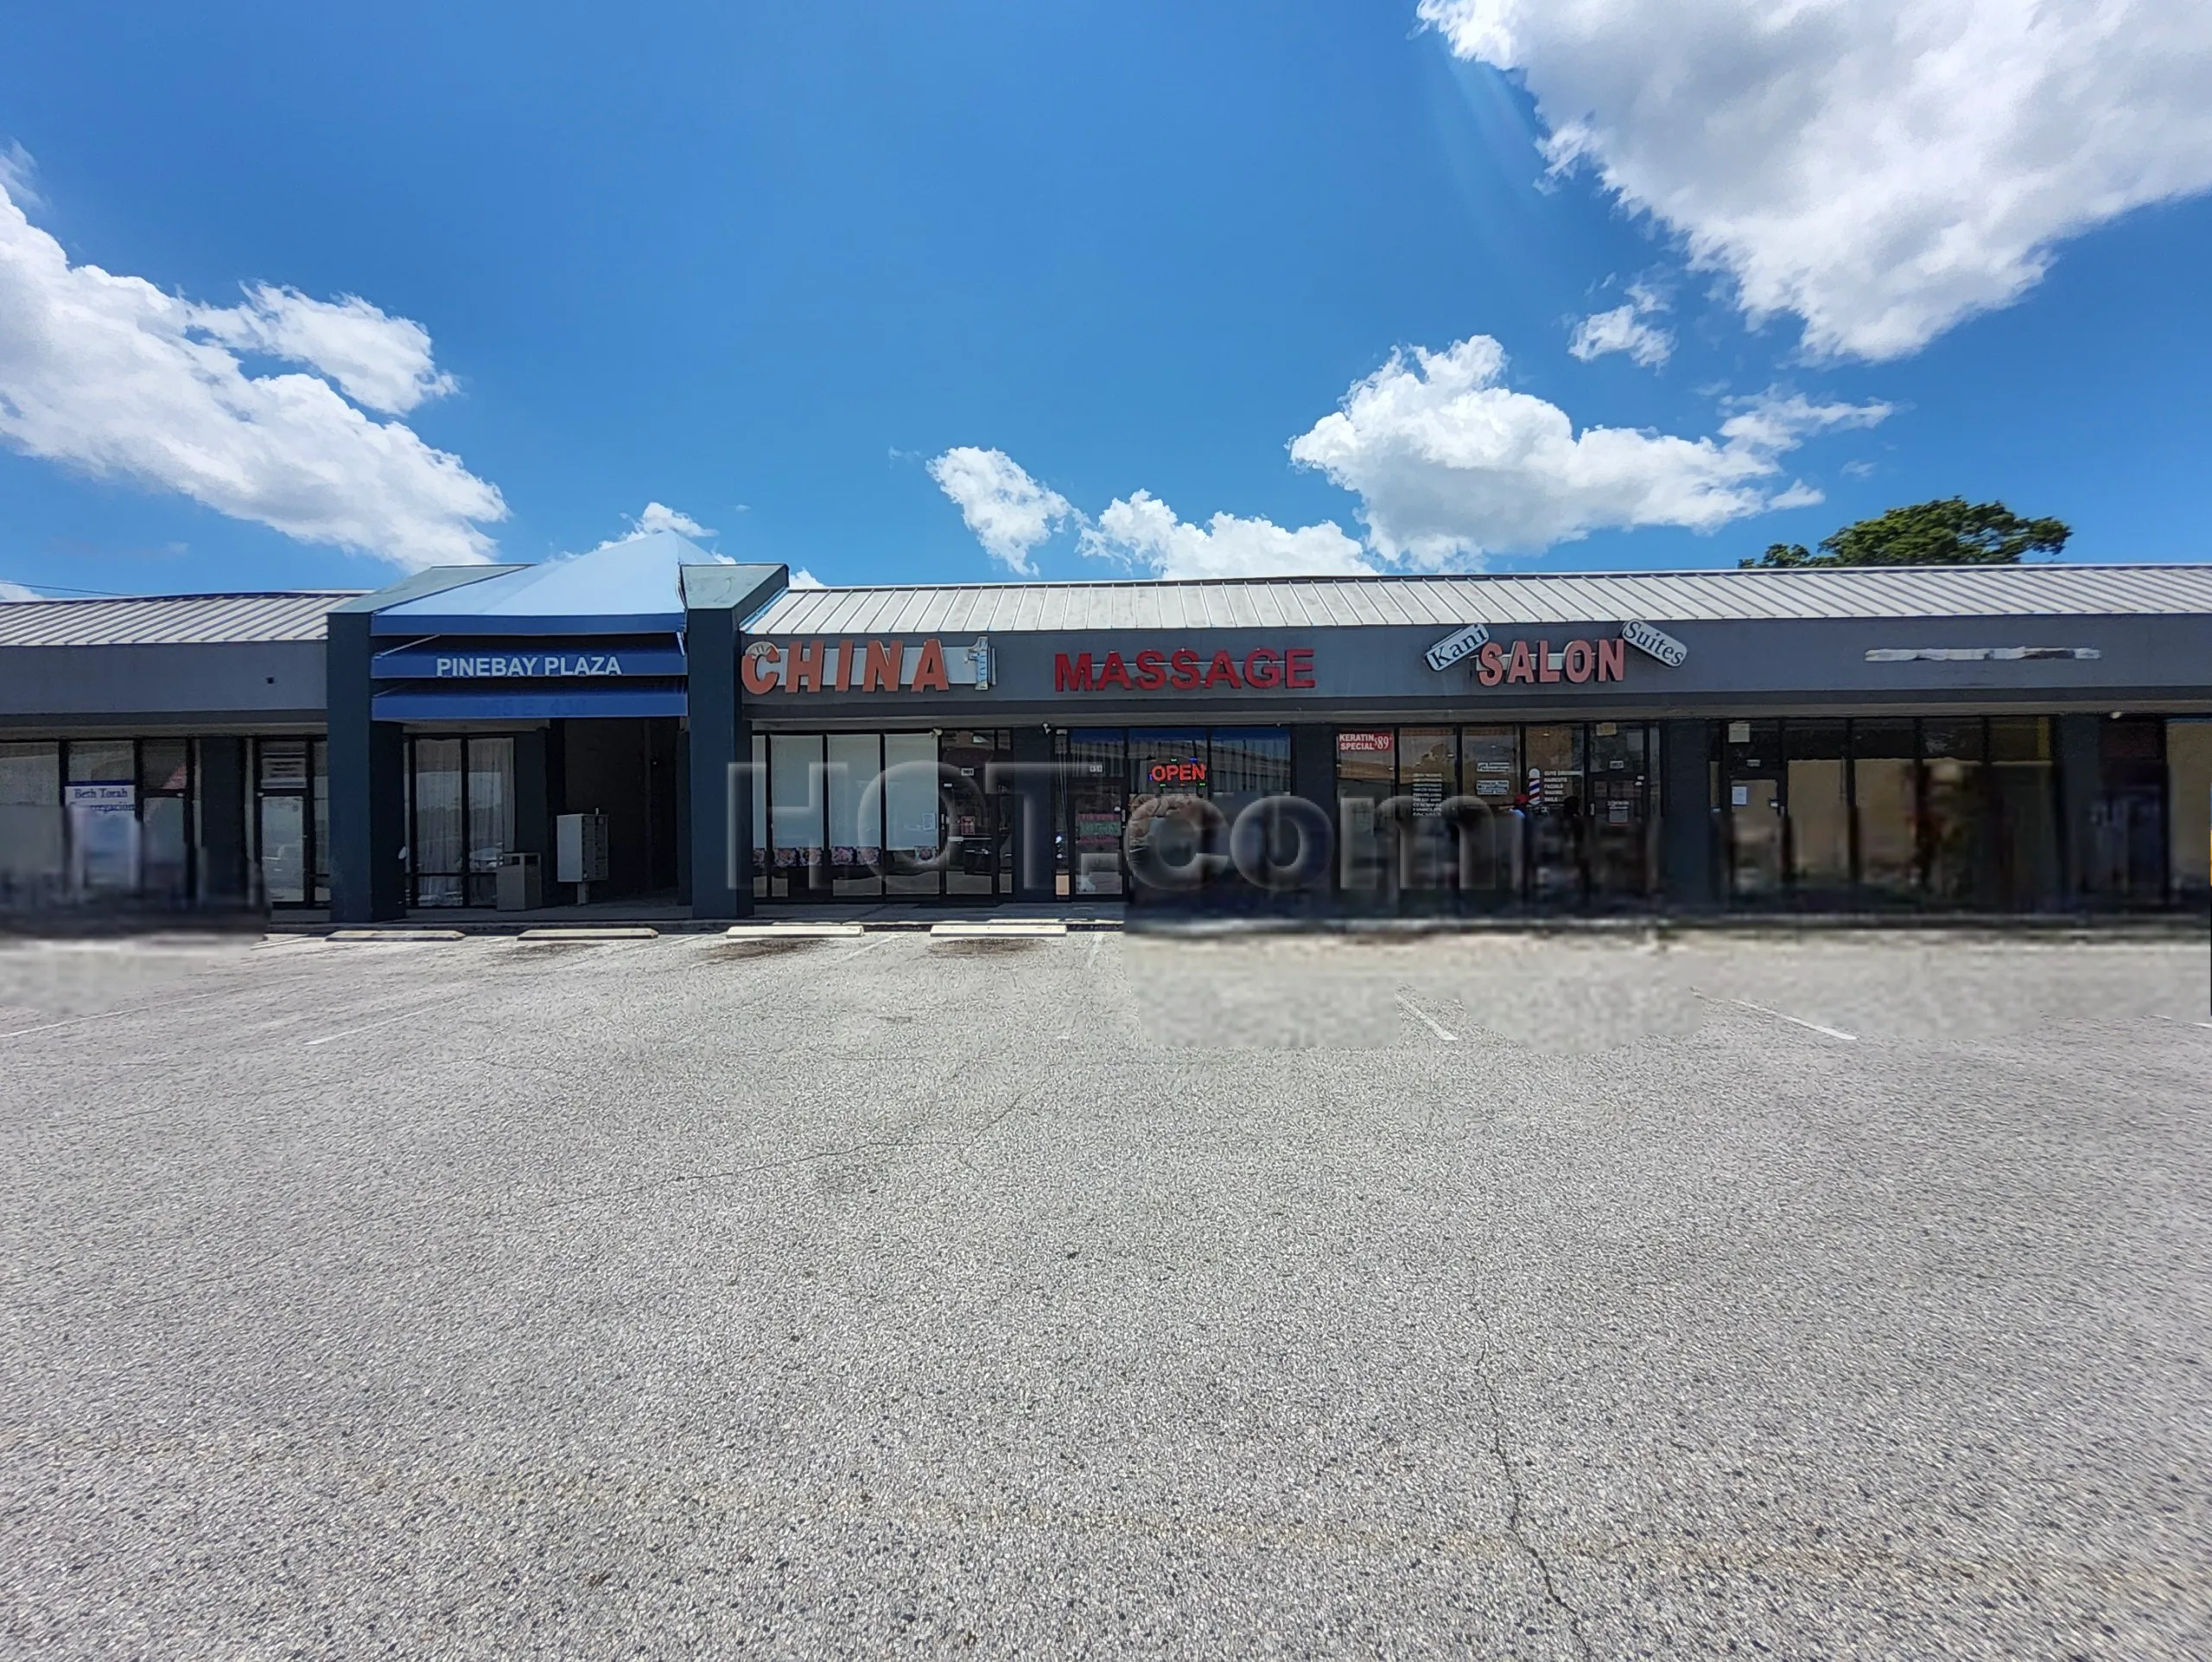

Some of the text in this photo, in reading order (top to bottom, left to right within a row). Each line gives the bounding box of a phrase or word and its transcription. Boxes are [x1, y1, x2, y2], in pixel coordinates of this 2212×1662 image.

[1430, 623, 1488, 669] Kani
[1478, 638, 1625, 686] SALON
[1624, 621, 1685, 665] Suites
[436, 656, 623, 677] PINEBAY PLAZA
[741, 638, 950, 695] CHINA
[1054, 649, 1317, 692] MASSAGE
[74, 787, 129, 799] Beth Torah
[1152, 763, 1207, 781] OPEN
